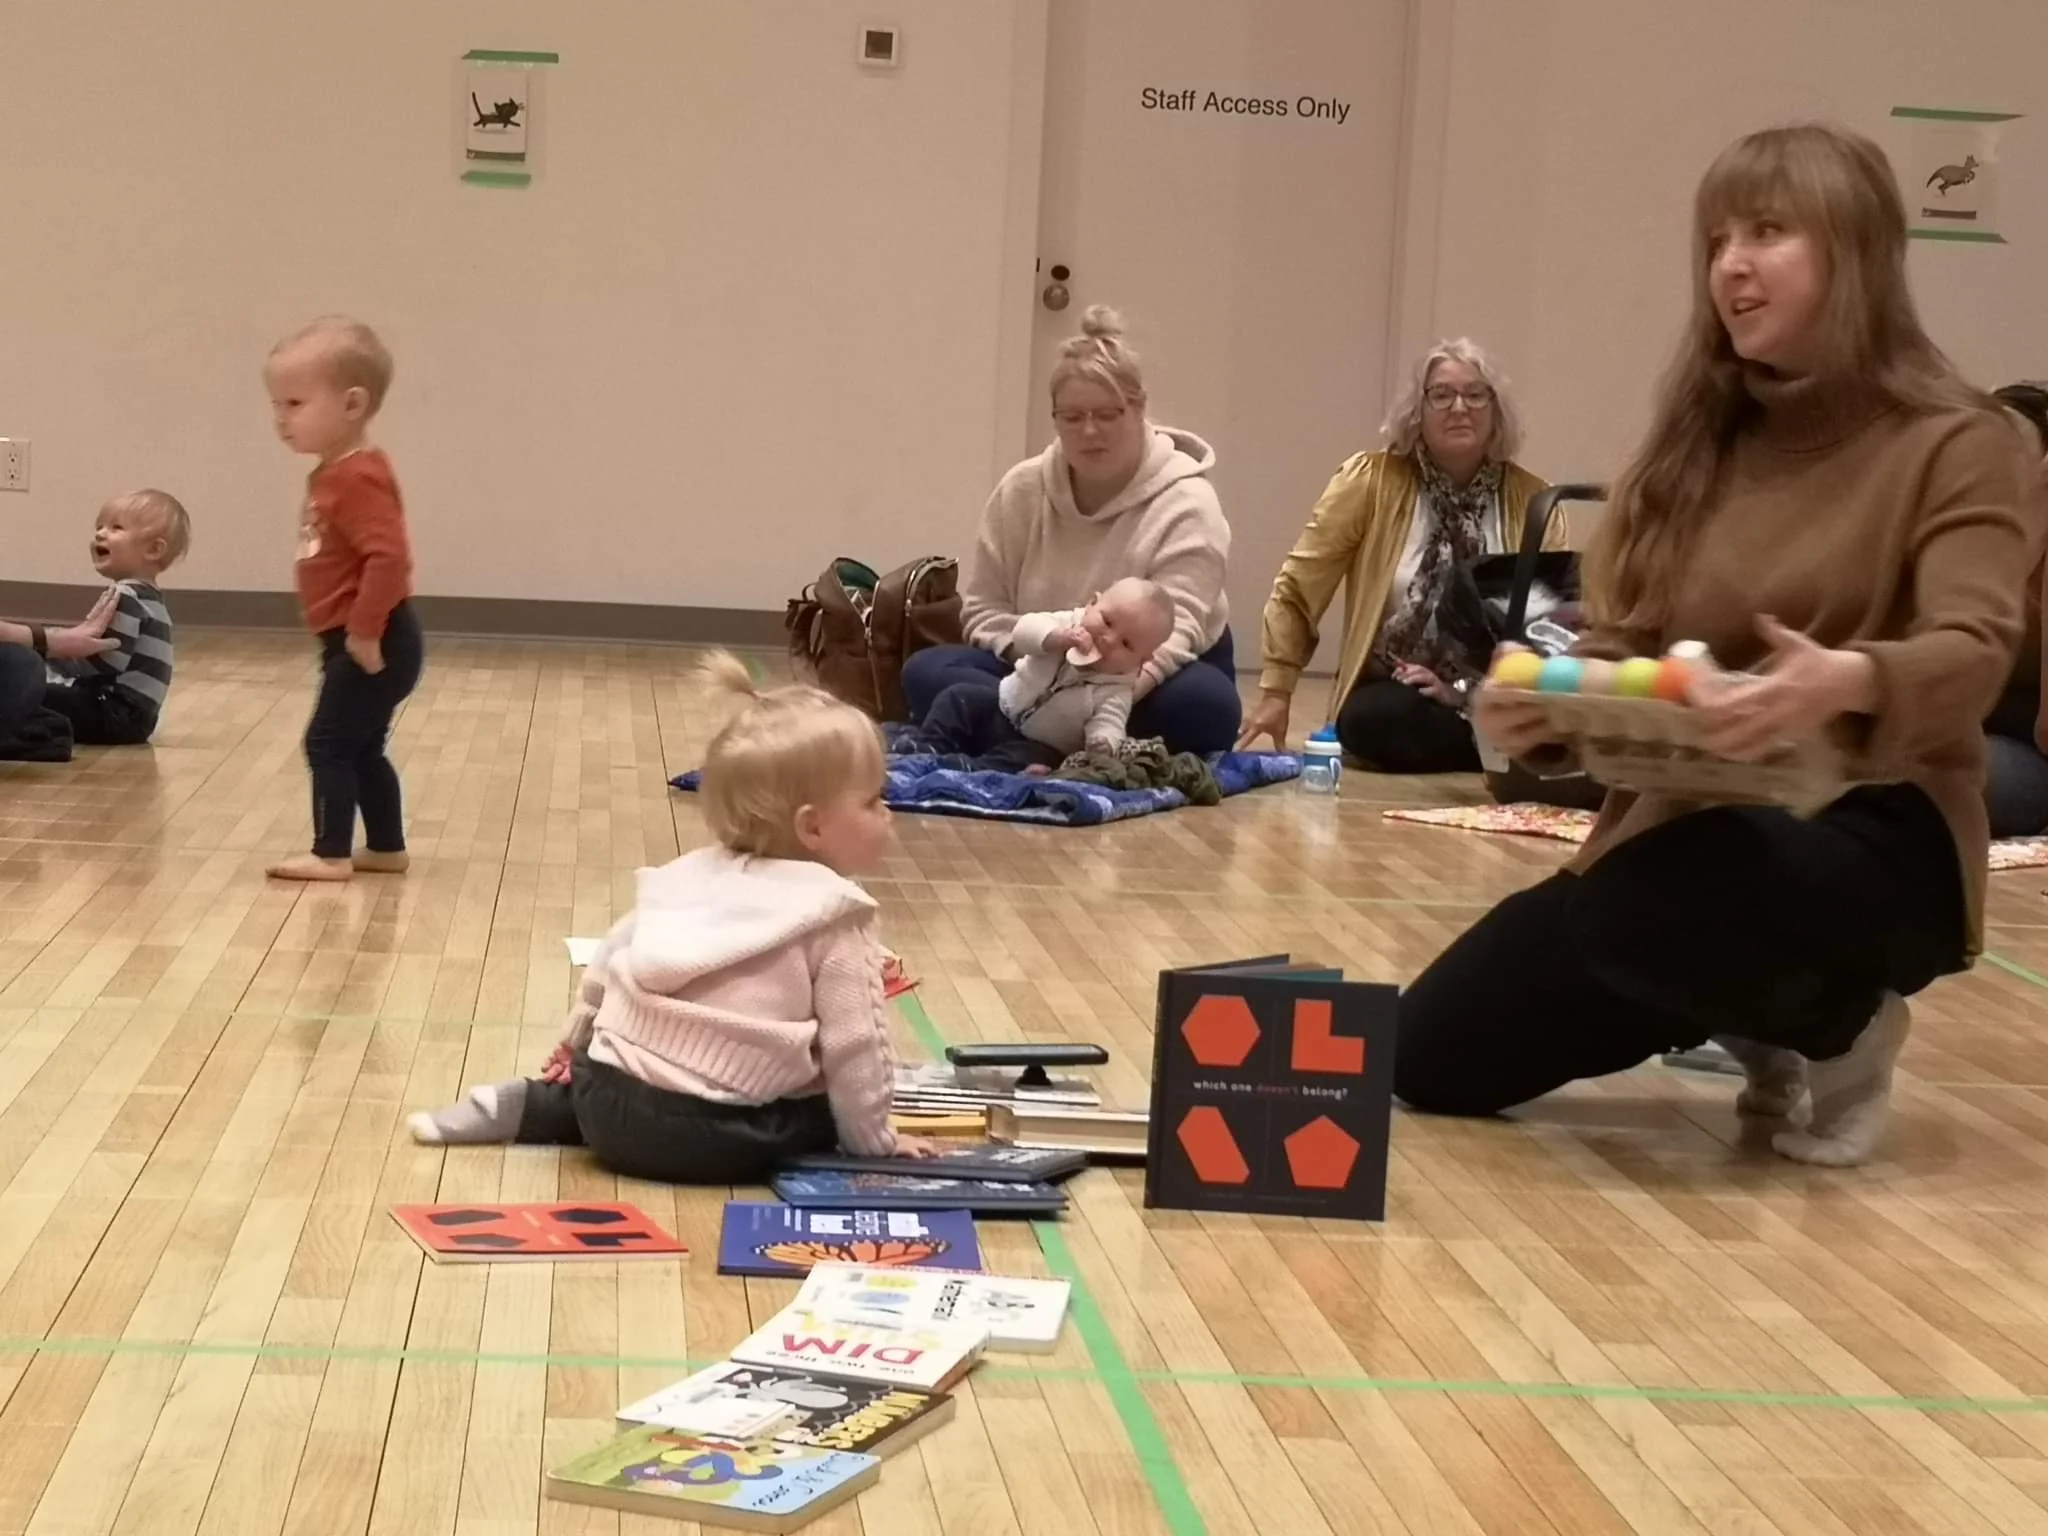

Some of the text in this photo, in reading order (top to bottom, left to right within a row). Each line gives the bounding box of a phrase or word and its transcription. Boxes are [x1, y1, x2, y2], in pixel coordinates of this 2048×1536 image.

[1141, 87, 1350, 124] Staff Access Only
[1193, 1080, 1227, 1091] which
[1231, 1083, 1252, 1092] one
[1302, 1086, 1348, 1100] belong?
[782, 1334, 924, 1365] DIM
